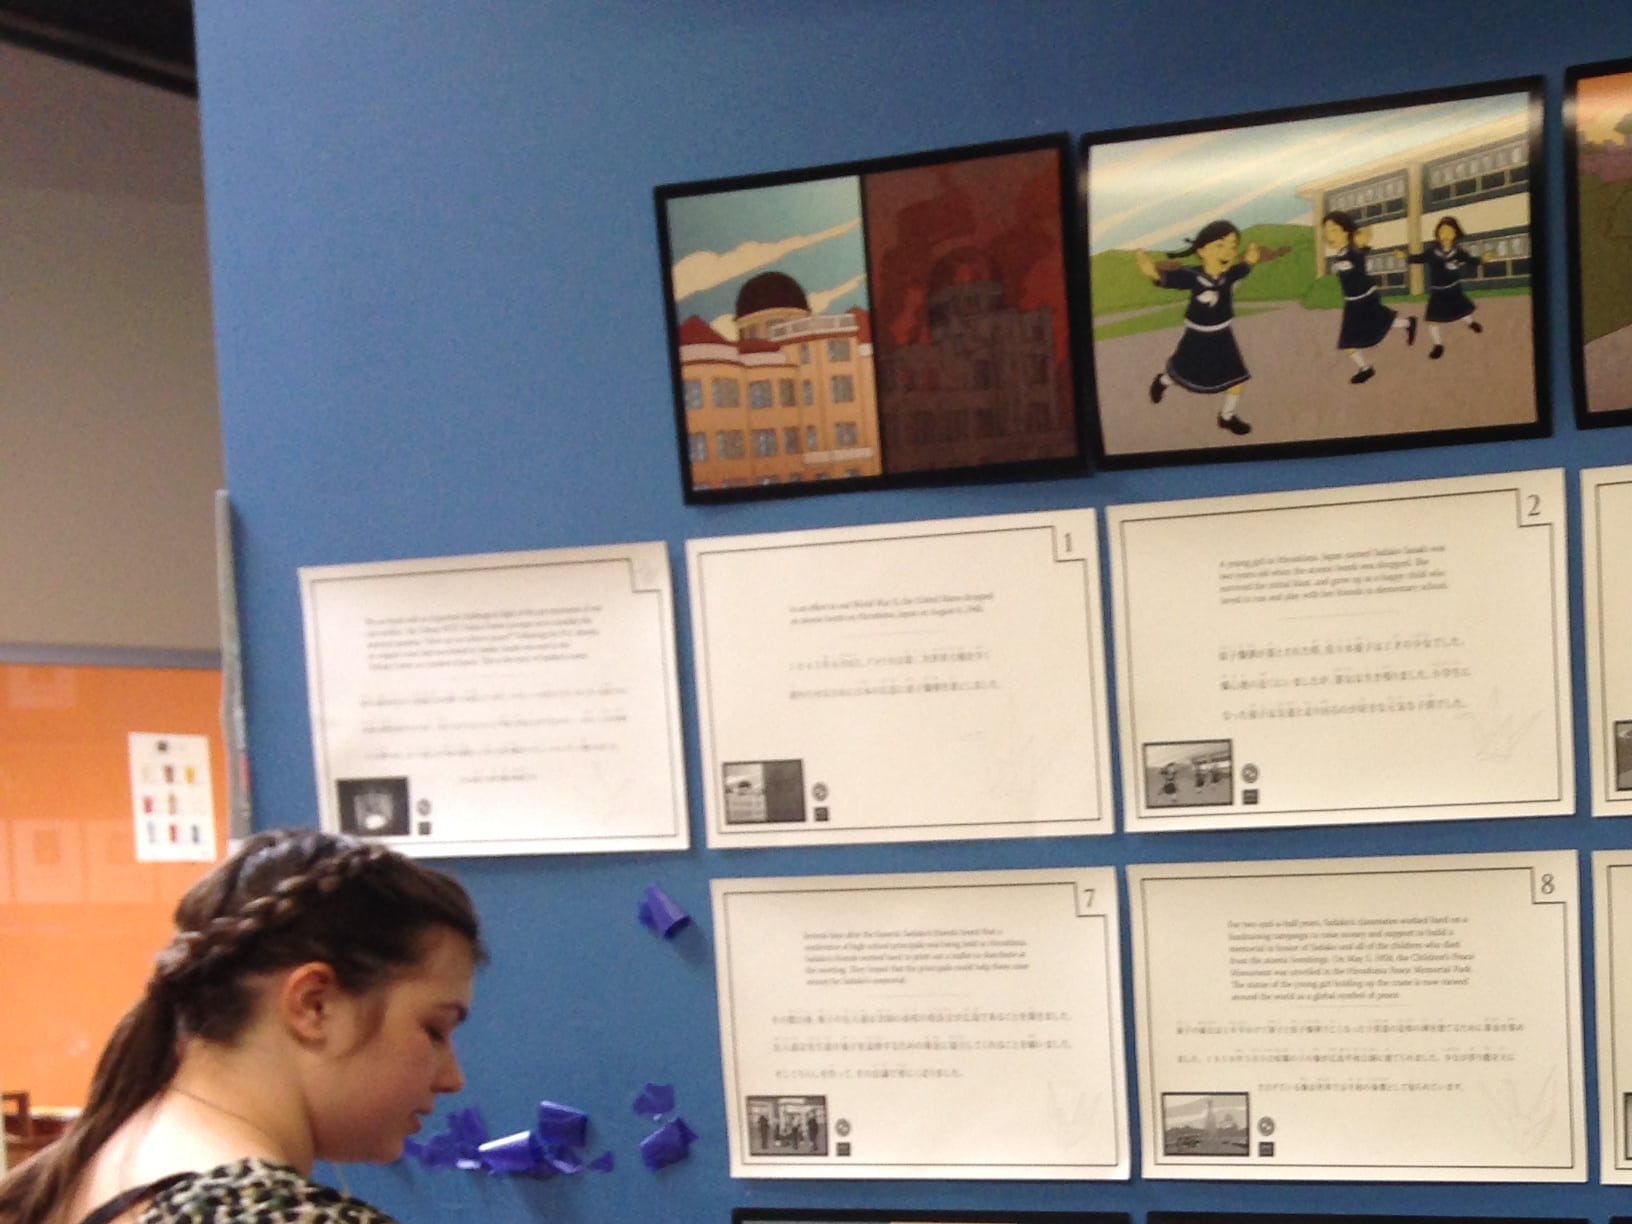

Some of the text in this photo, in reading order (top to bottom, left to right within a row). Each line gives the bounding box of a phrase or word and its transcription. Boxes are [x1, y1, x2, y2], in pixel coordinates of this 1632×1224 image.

[1527, 494, 1541, 517] 2
[1065, 532, 1072, 552] 1
[1541, 873, 1555, 895] 8
[1084, 888, 1096, 908] 7
